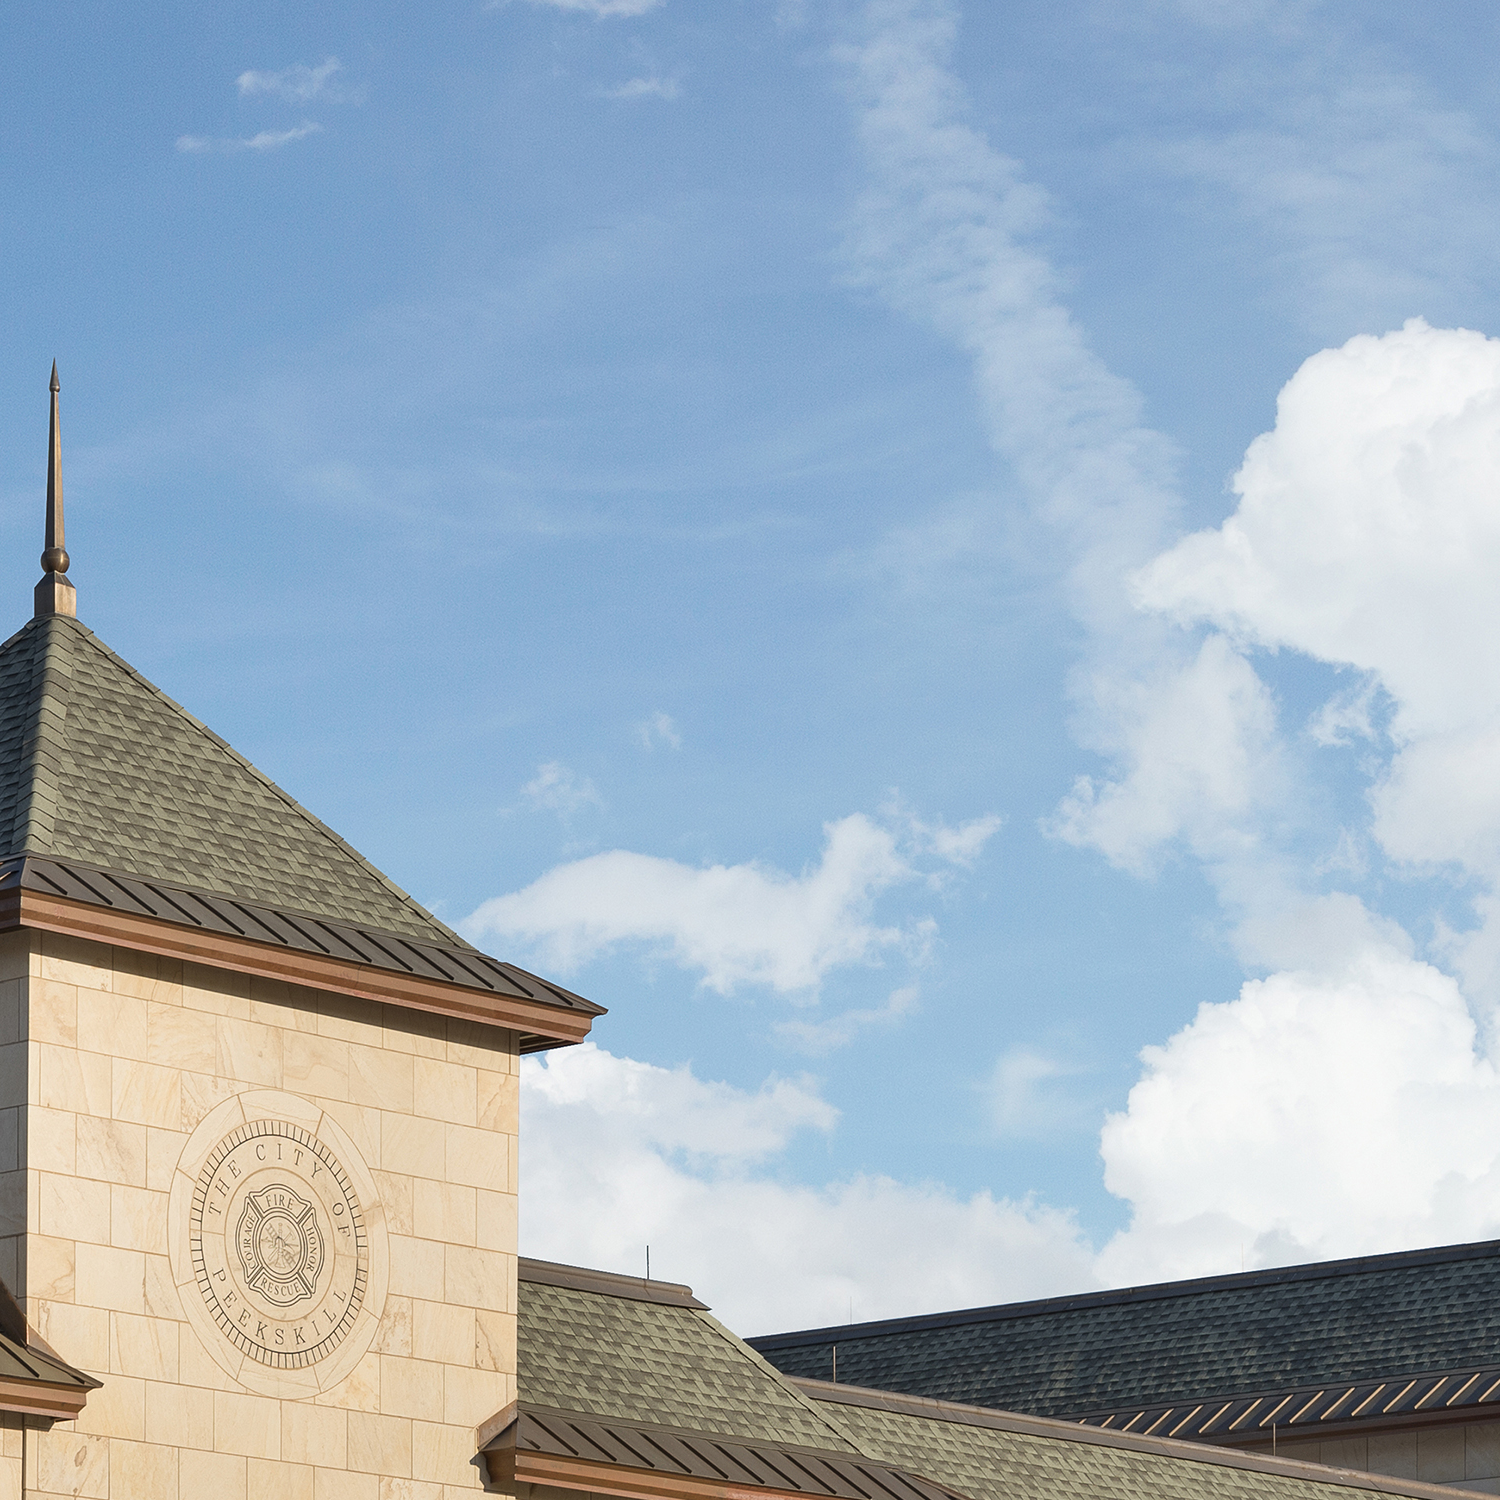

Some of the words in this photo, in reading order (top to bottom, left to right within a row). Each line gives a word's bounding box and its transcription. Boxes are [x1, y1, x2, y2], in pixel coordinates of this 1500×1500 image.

[208, 1159, 242, 1216] THE
[255, 1143, 323, 1180] CITY
[332, 1202, 351, 1238] OF
[265, 1193, 295, 1211] FIRE
[243, 1212, 257, 1270] COURAGE
[305, 1226, 318, 1272] HONOR
[211, 1267, 347, 1346] PEEKSKILL
[260, 1277, 301, 1297] RESCUE
